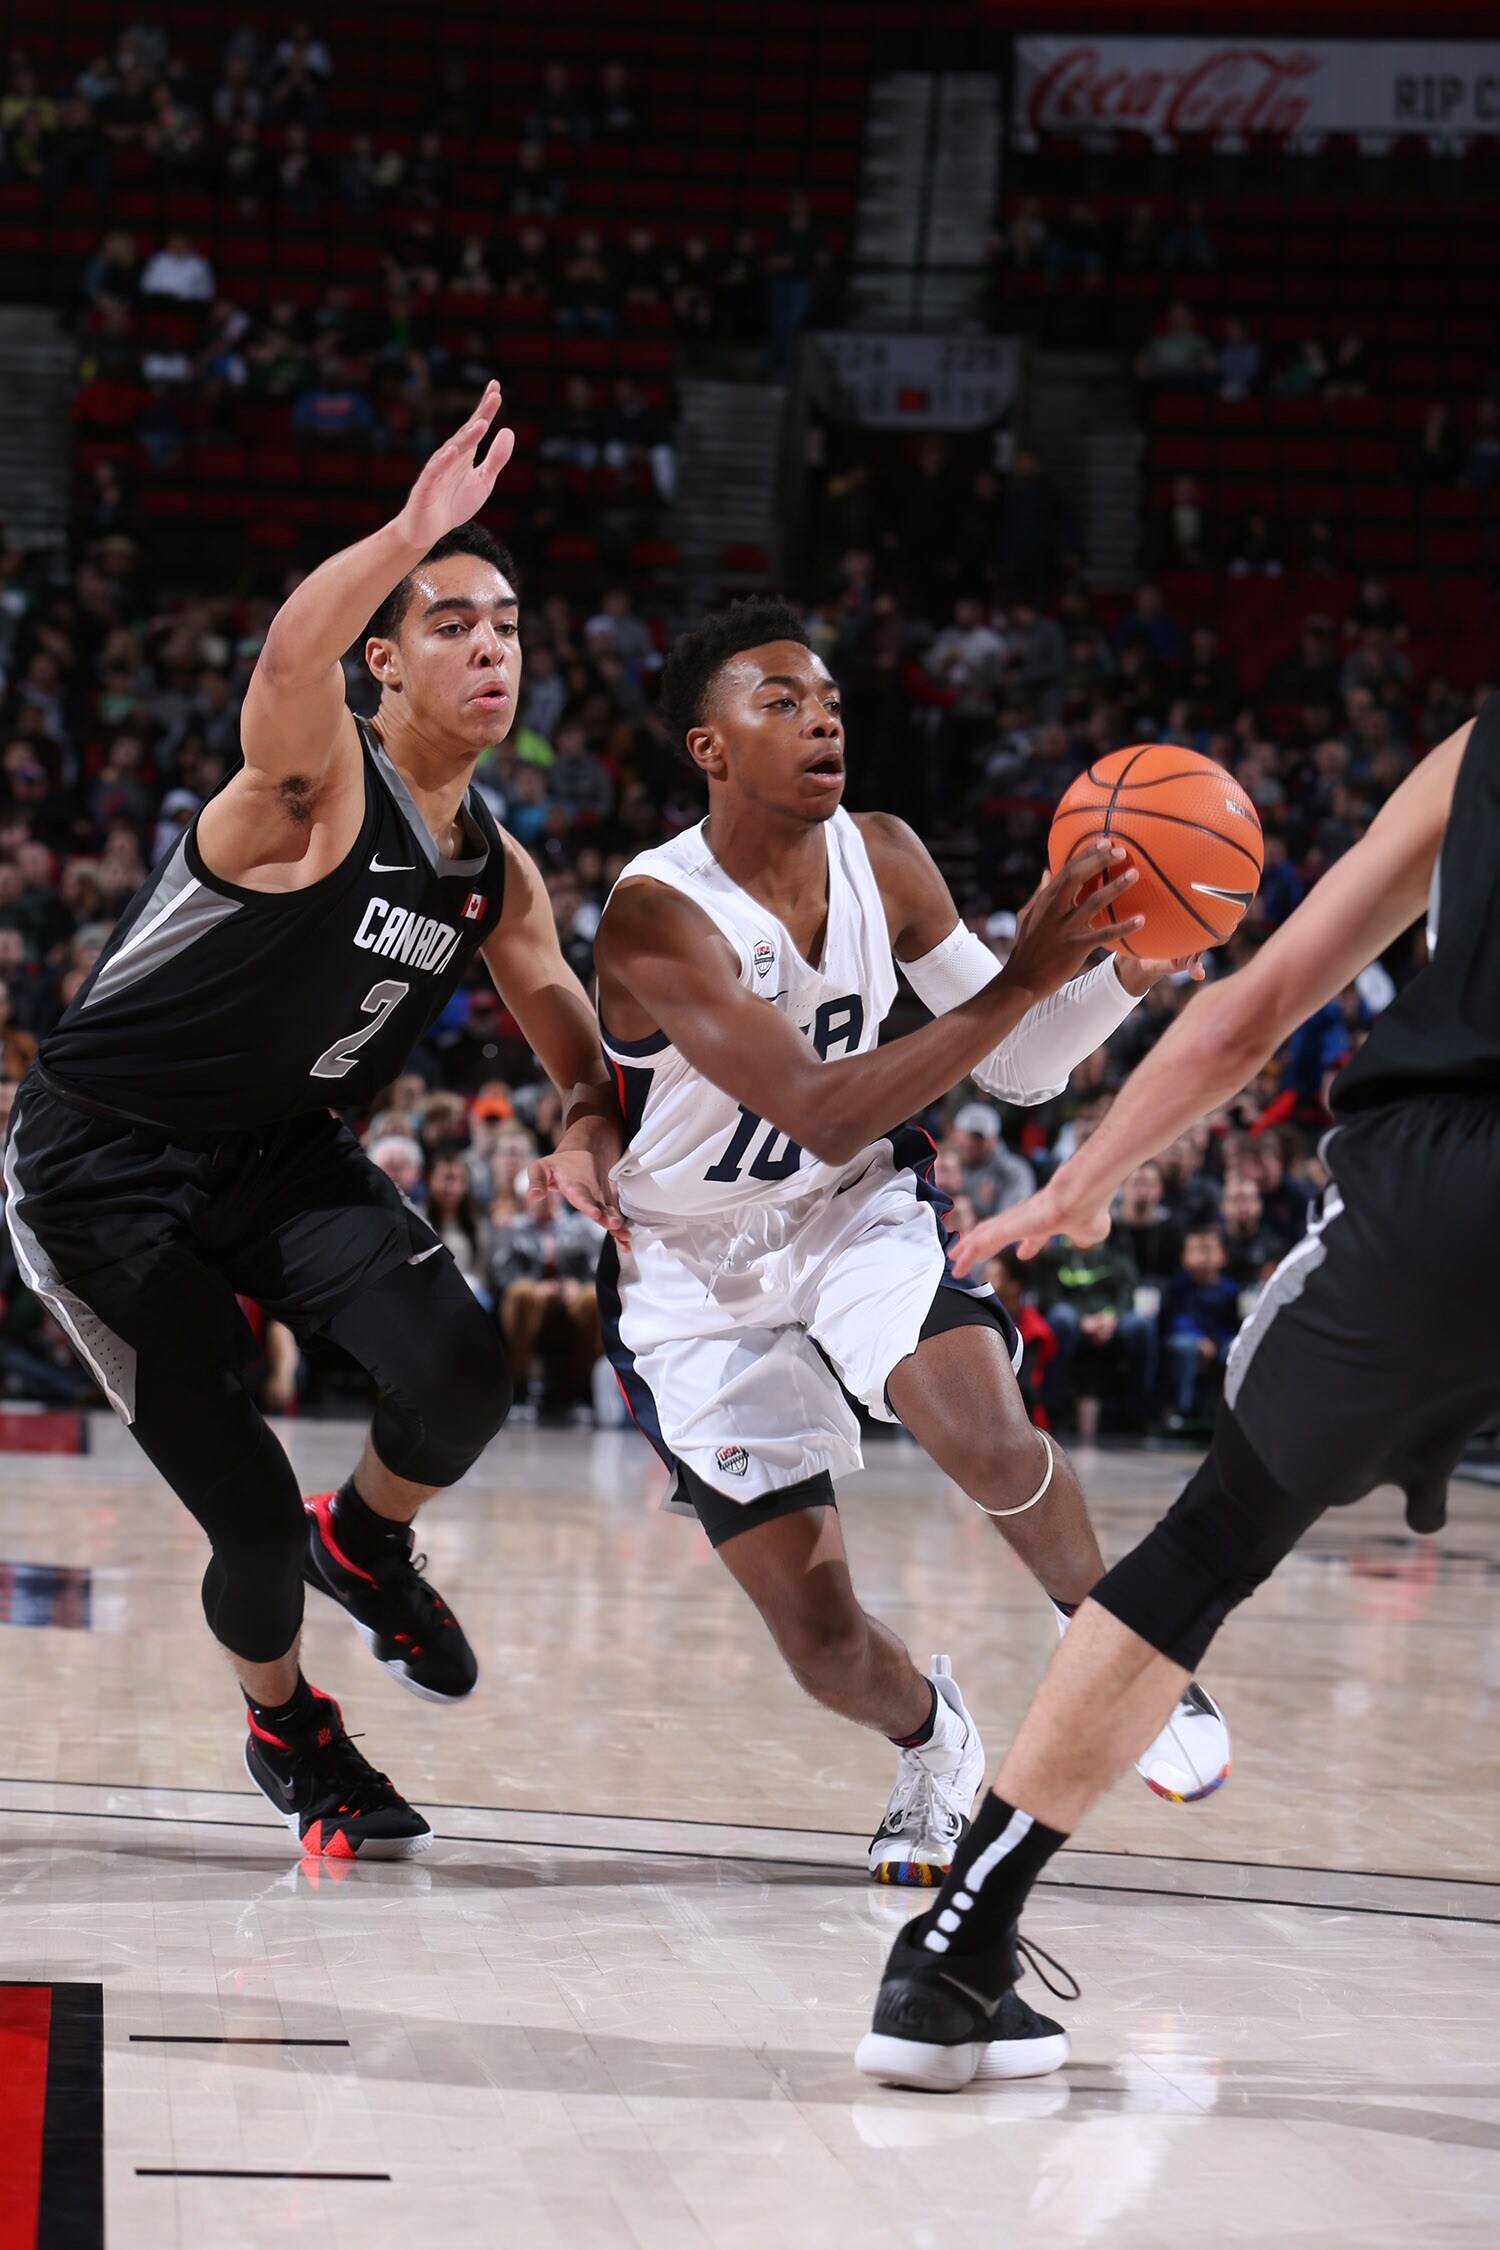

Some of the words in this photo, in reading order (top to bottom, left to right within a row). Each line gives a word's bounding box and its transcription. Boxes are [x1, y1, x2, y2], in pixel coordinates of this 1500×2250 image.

[1393, 71, 1465, 121] RIP
[353, 896, 464, 976] CANADA
[309, 979, 410, 1078] 2
[719, 1445, 740, 1461] USA
